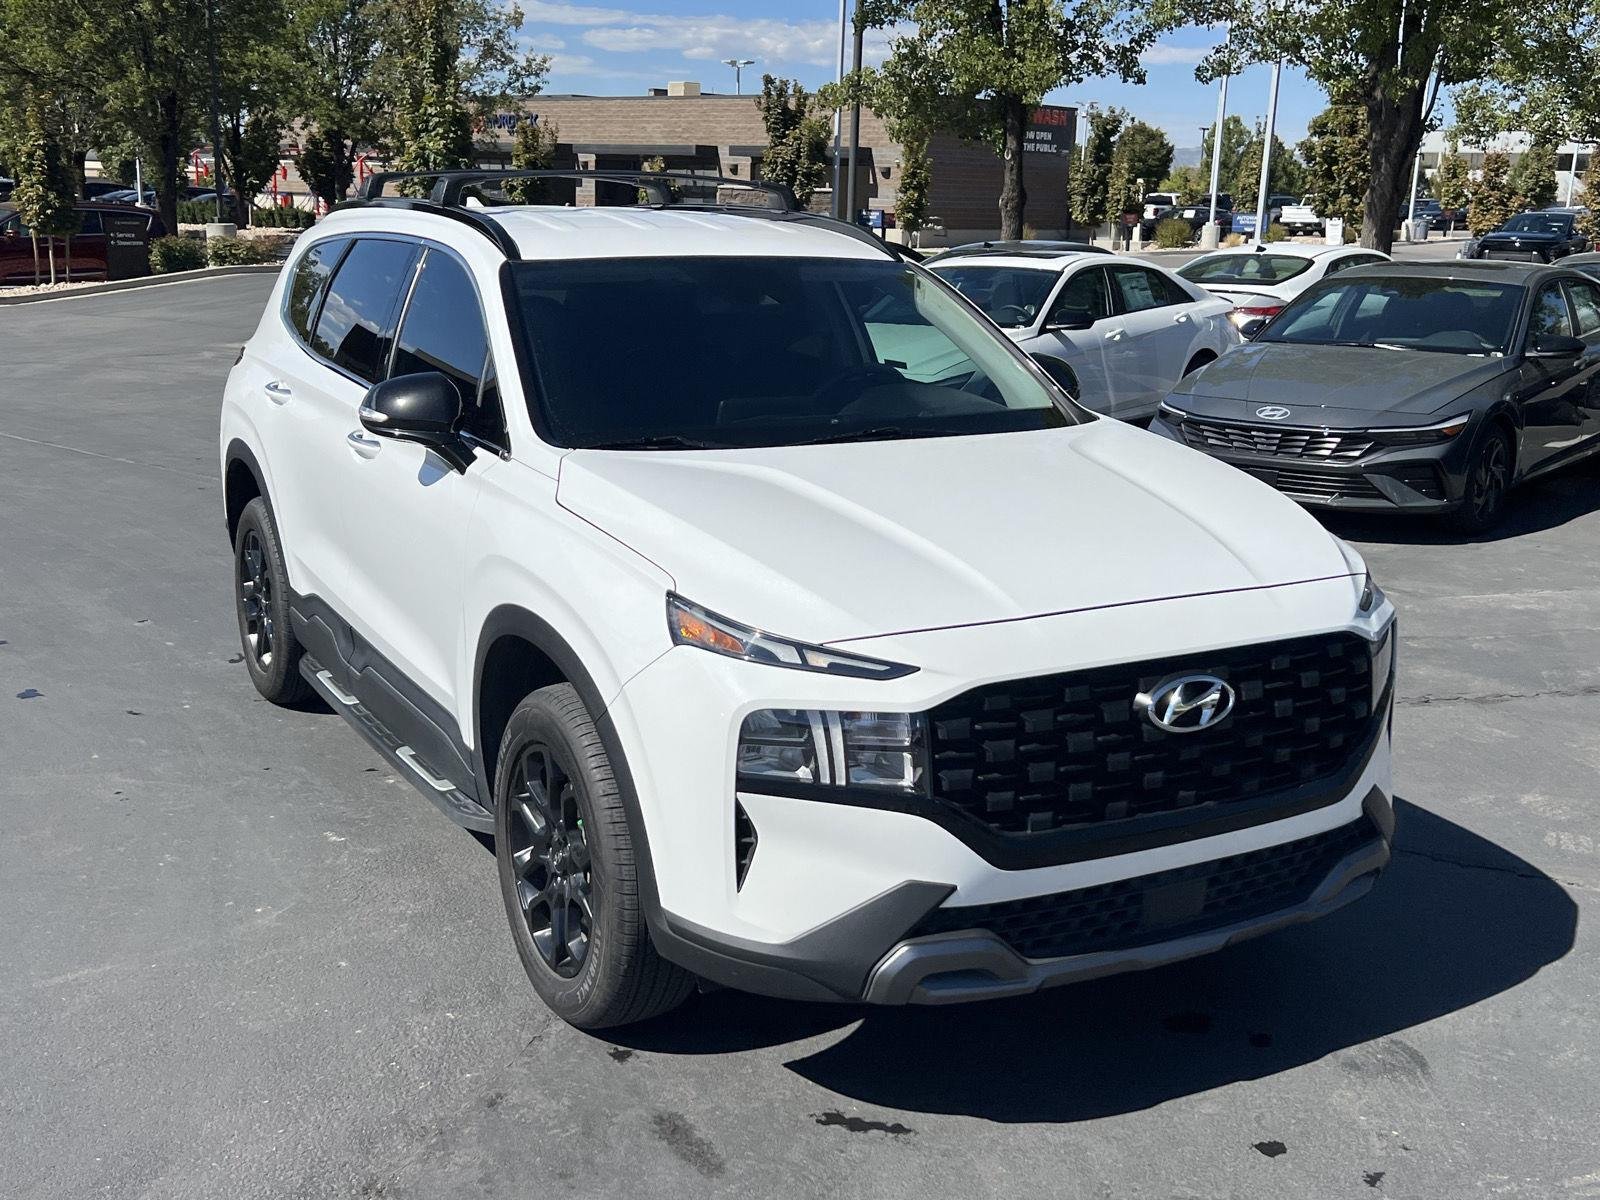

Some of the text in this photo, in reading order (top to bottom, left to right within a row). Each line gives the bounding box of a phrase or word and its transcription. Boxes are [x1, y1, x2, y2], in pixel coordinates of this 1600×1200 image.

[1036, 131, 1053, 141] OPEN
[1023, 143, 1058, 153] THE PUBLIC
